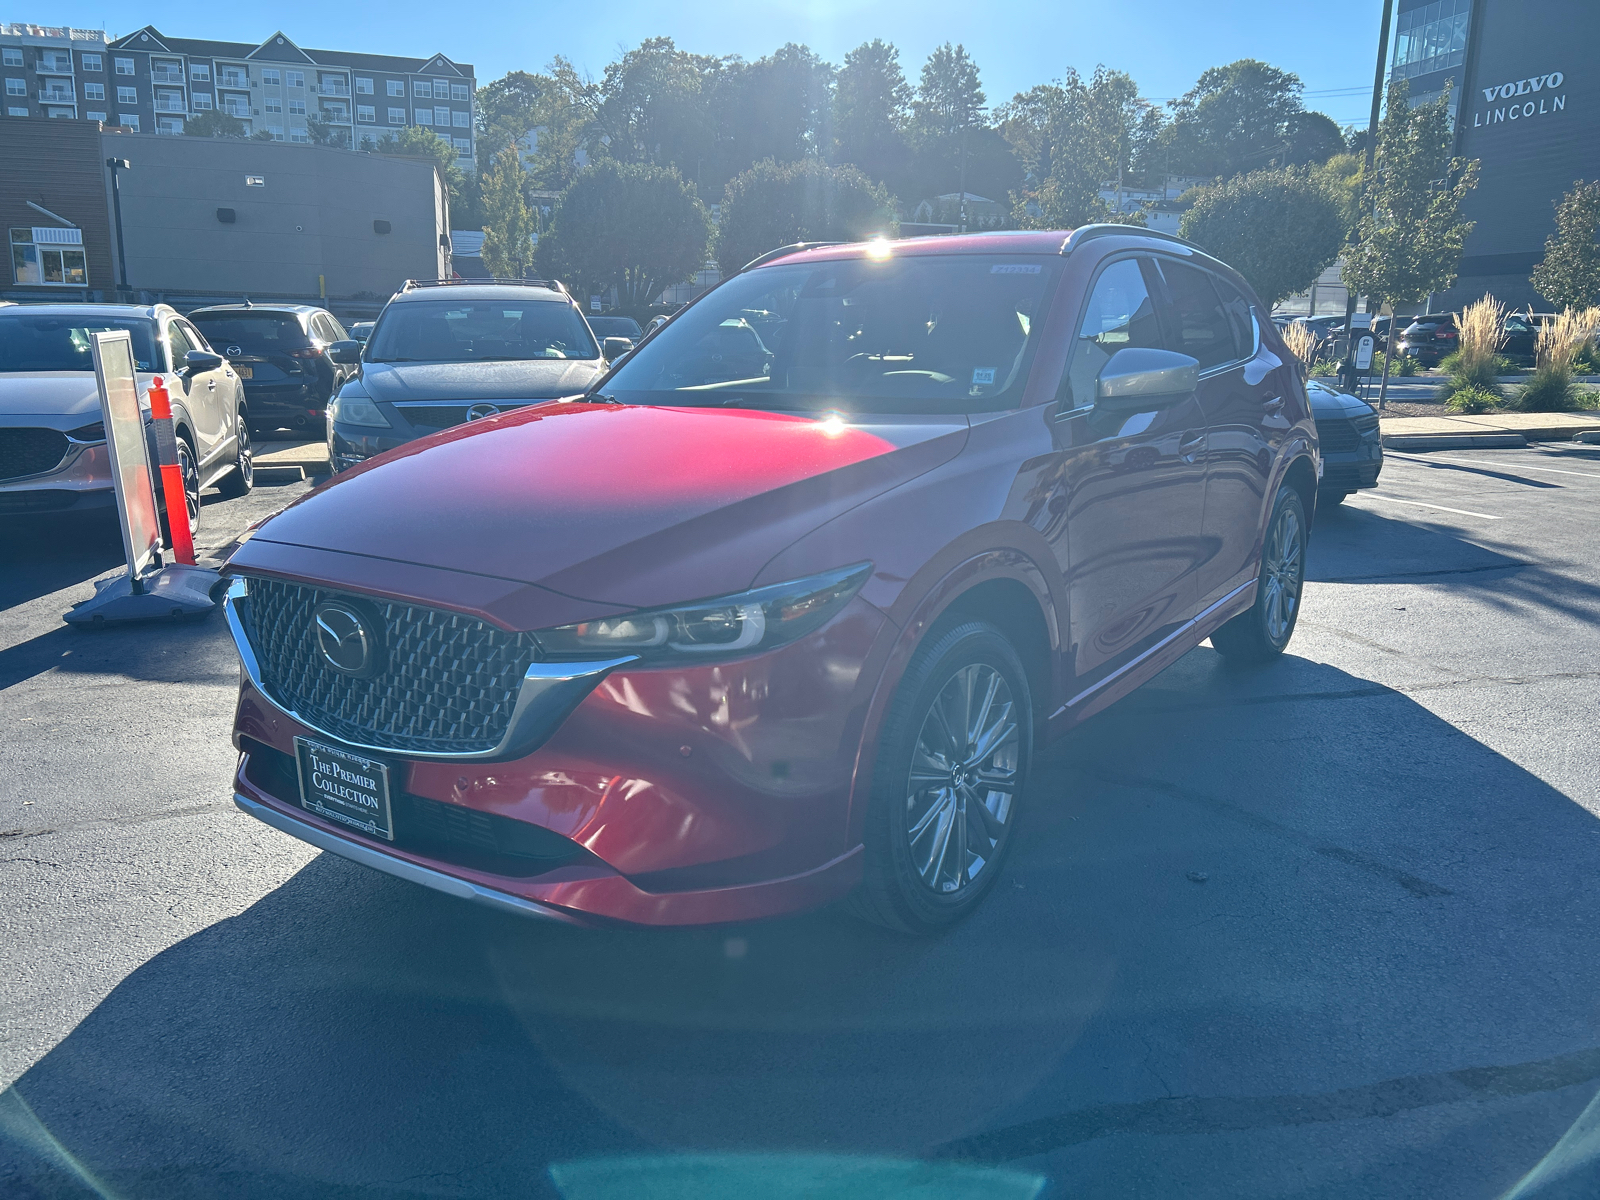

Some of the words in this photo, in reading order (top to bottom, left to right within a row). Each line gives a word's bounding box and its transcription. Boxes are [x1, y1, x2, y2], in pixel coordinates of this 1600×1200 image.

[1482, 72, 1564, 102] VOLVO
[1474, 95, 1566, 128] LINCOLN
[310, 754, 332, 776] THE
[332, 762, 377, 791] PREMIER
[312, 771, 379, 809] COLLECTION
